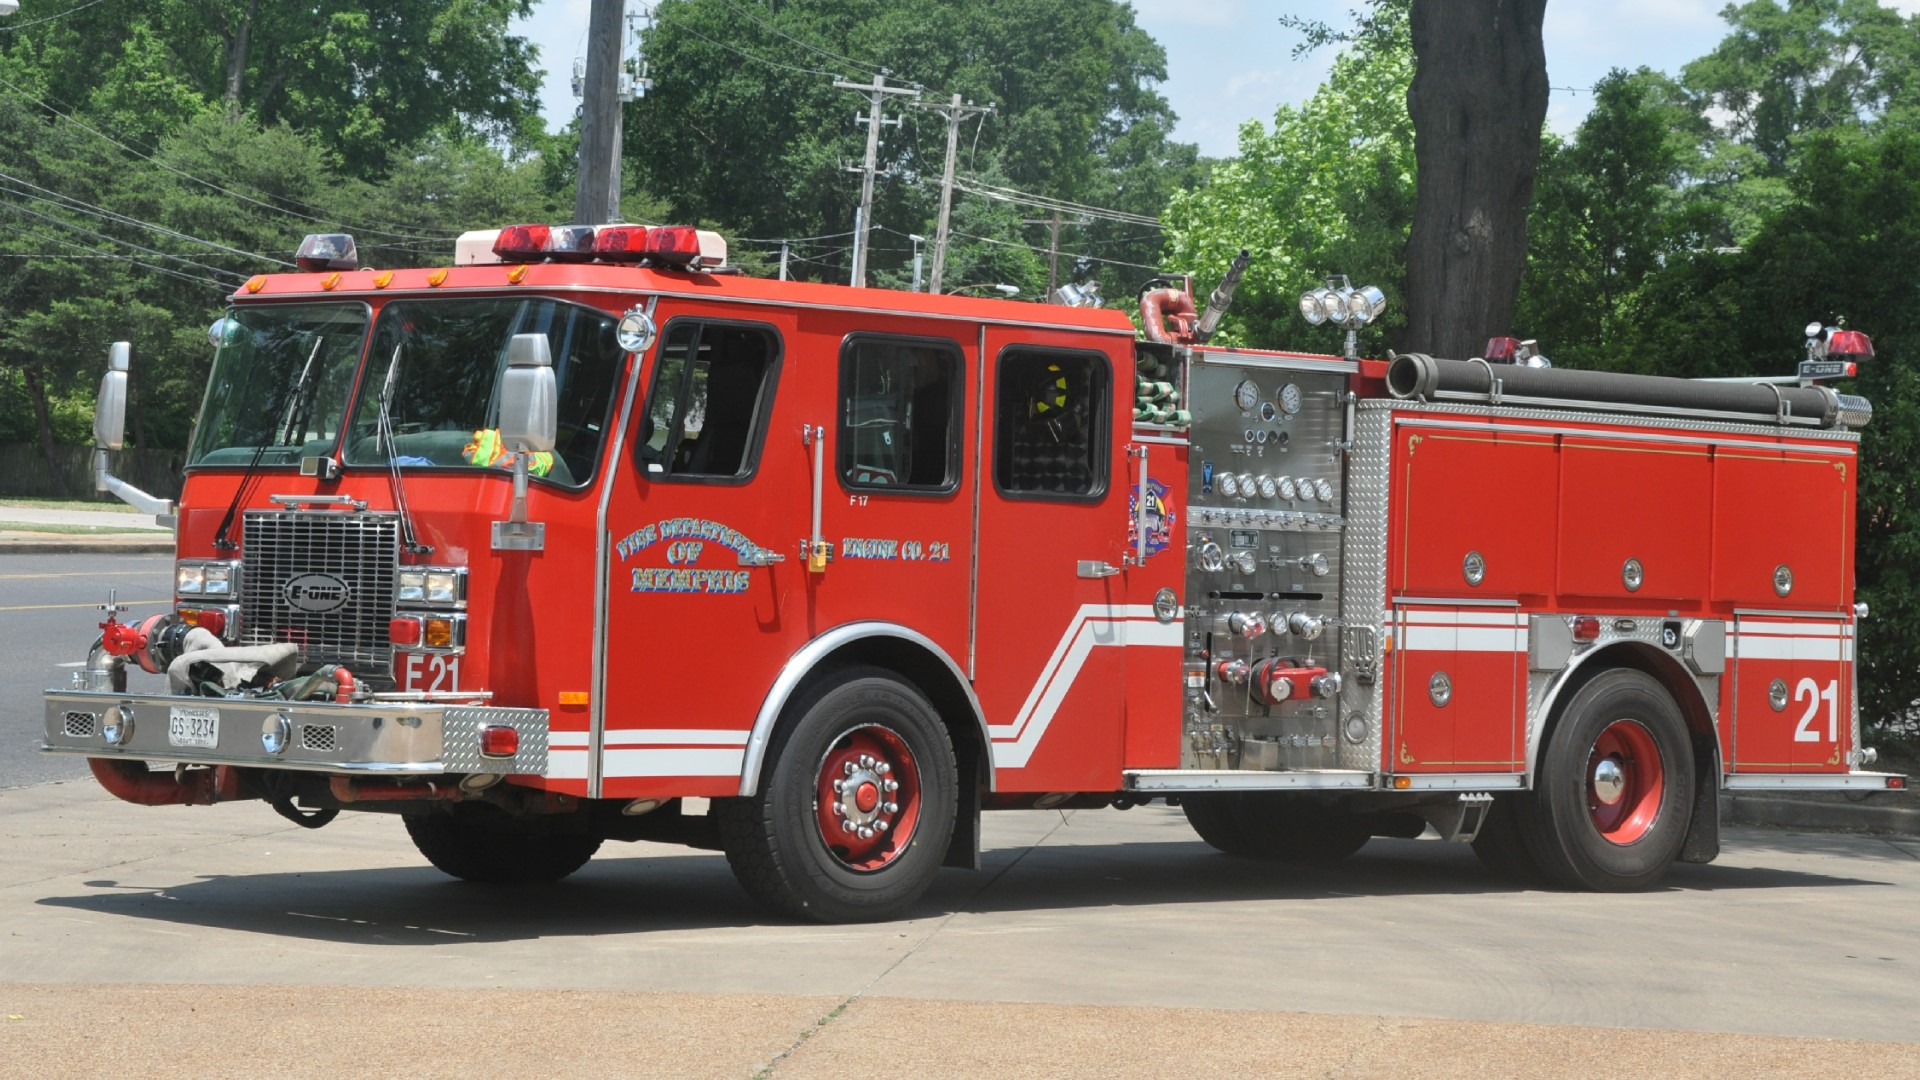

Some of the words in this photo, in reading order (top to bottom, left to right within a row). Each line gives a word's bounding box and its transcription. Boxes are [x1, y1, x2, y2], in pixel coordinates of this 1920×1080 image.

[1803, 365, 1840, 373] E-ONE
[1146, 495, 1155, 506] 21
[616, 523, 657, 562] FIRE
[659, 517, 764, 565] DEPARTMENT
[667, 541, 703, 565] OF
[842, 537, 898, 559] ENGINE
[901, 541, 926, 561] CO.
[928, 541, 950, 561] 21
[631, 567, 750, 593] MEMPHIS
[291, 585, 341, 600] E-ONE
[1794, 677, 1838, 742] 21
